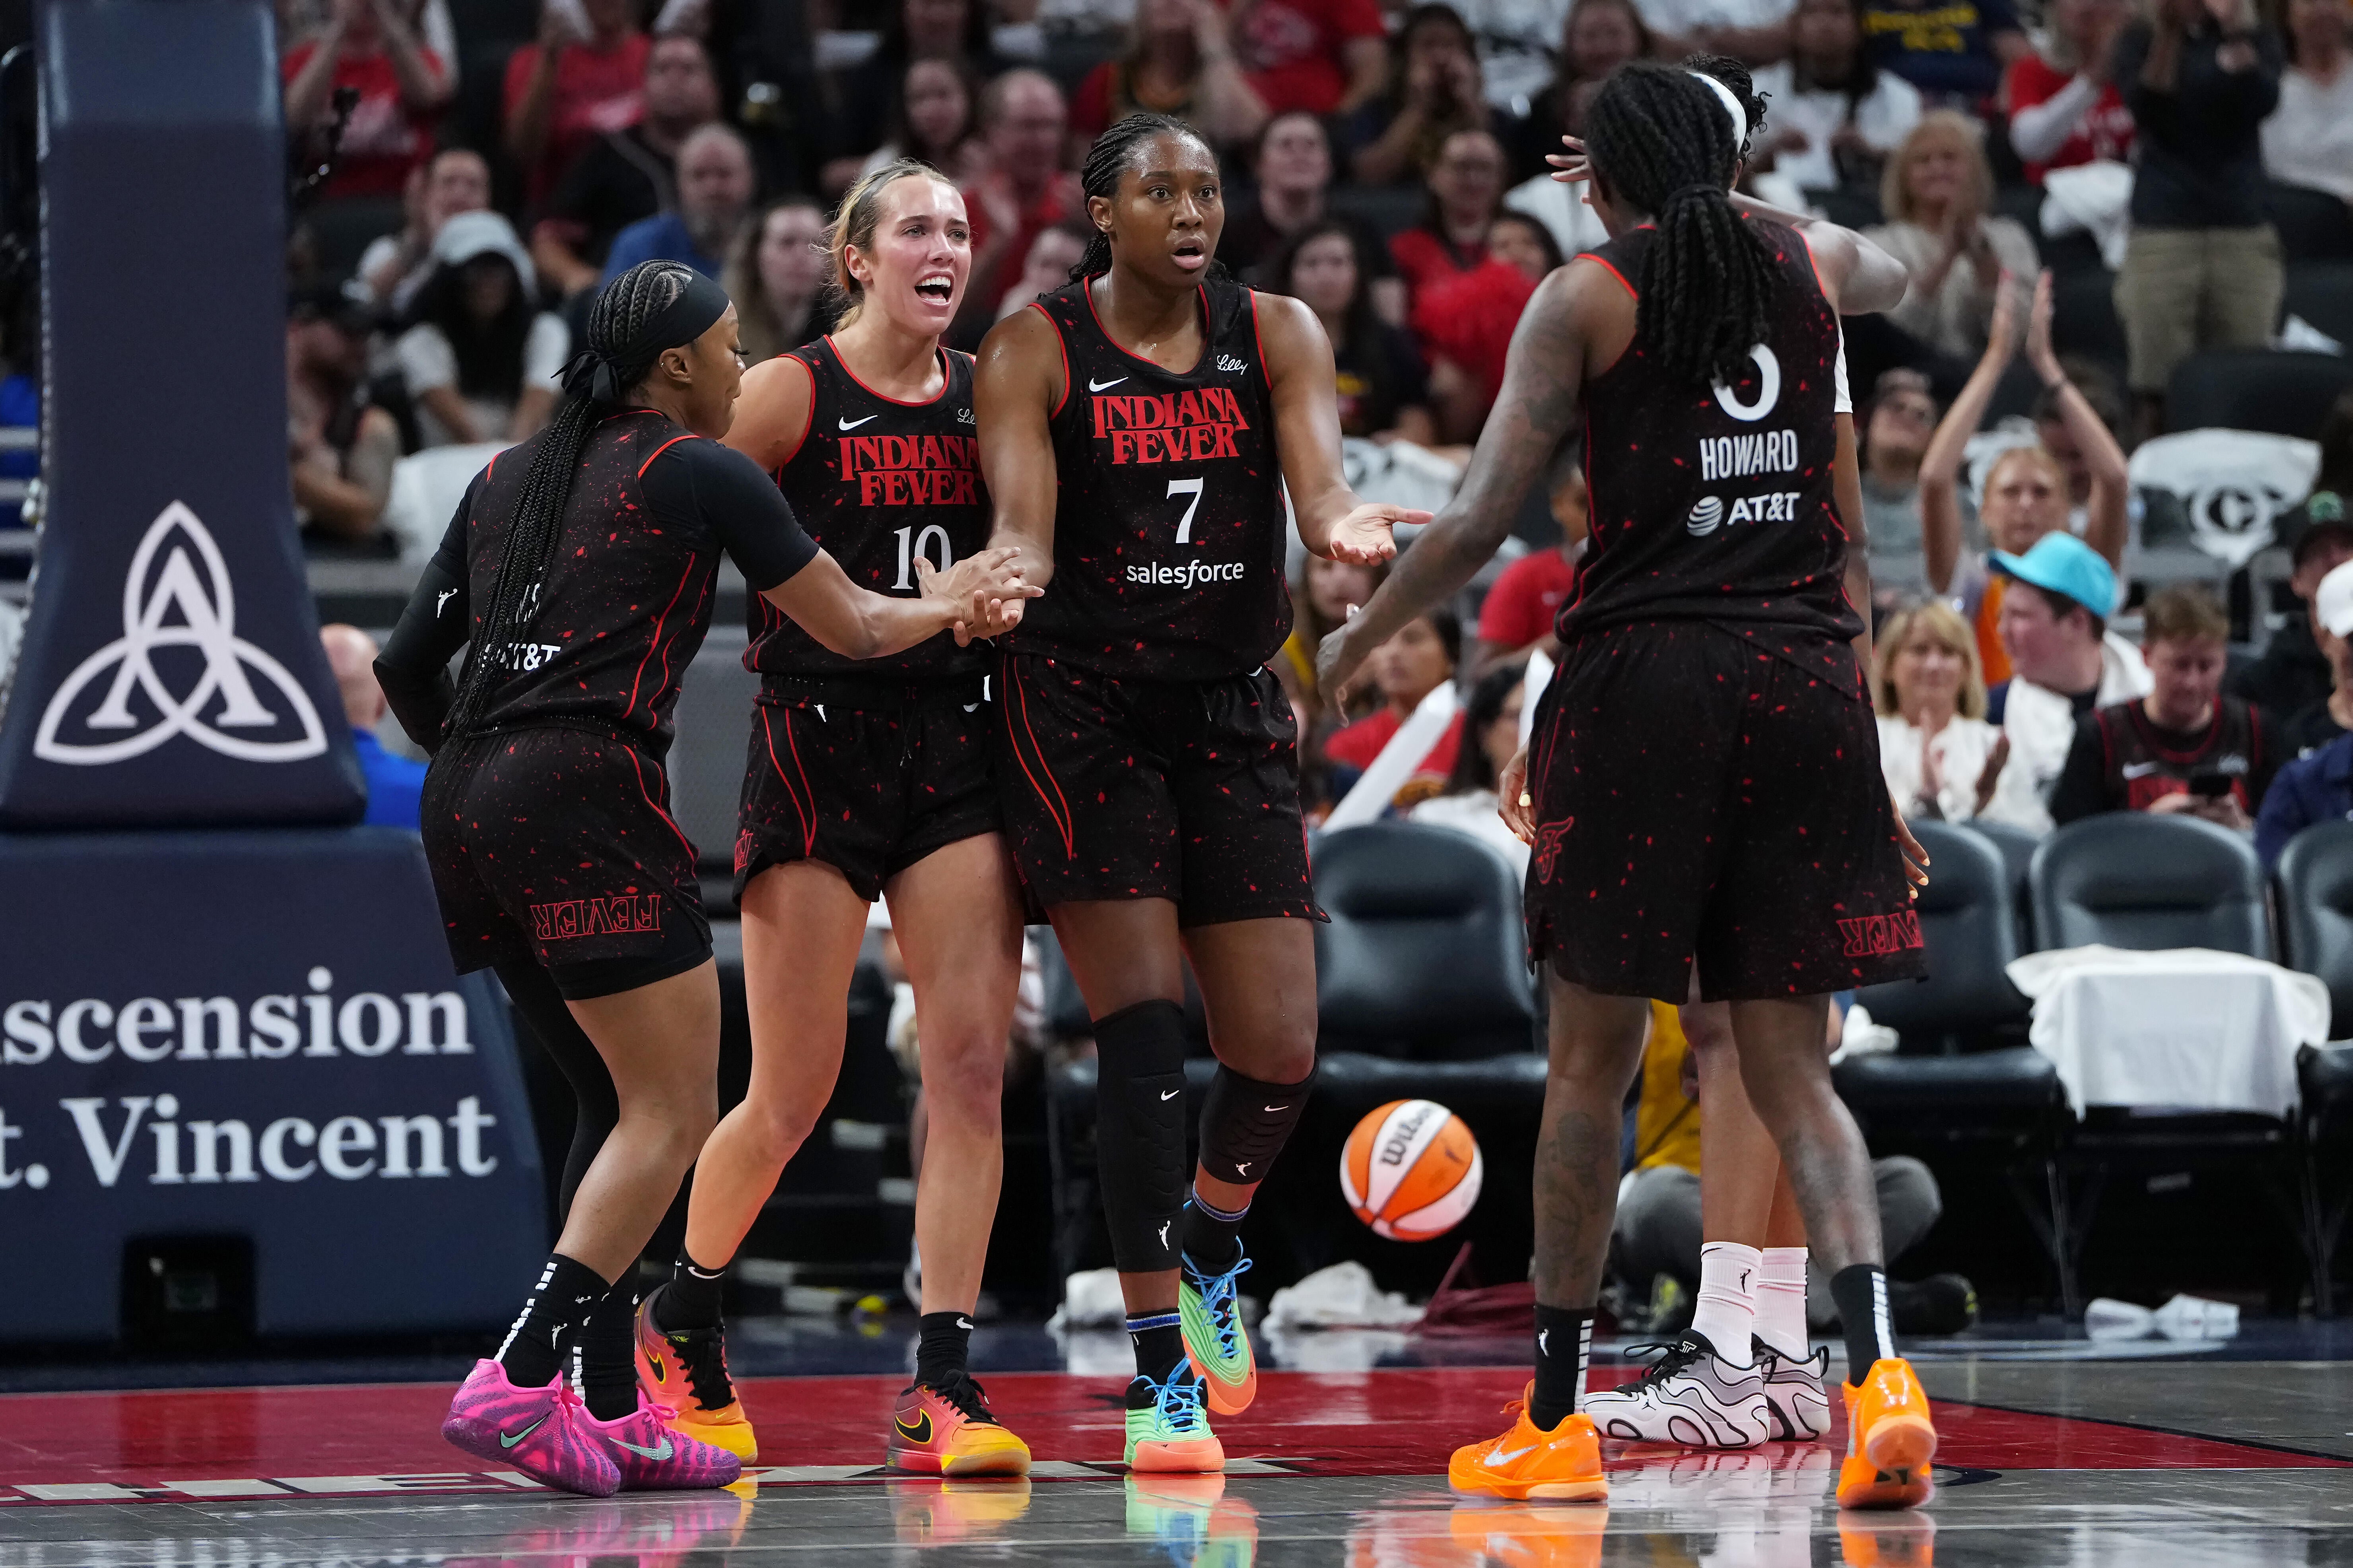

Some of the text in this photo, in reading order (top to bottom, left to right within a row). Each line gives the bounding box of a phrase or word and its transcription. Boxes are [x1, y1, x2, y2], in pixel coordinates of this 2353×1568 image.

[1217, 354, 1248, 375] Lilly
[957, 408, 976, 425] Lil
[1091, 388, 1250, 439] INDIANA
[837, 435, 984, 481] INDIANA
[1109, 423, 1240, 465] FEVER
[1699, 429, 1798, 481] HOWARD
[858, 470, 978, 506] FEVER
[1166, 476, 1204, 544] 7
[1727, 492, 1801, 525] AT&T
[891, 524, 952, 590] 10
[1126, 559, 1244, 590] salesforce
[530, 895, 661, 940] FEVER
[1836, 909, 1924, 957] EVER
[0, 965, 476, 1065] scension
[0, 1093, 499, 1189] t. Vincent
